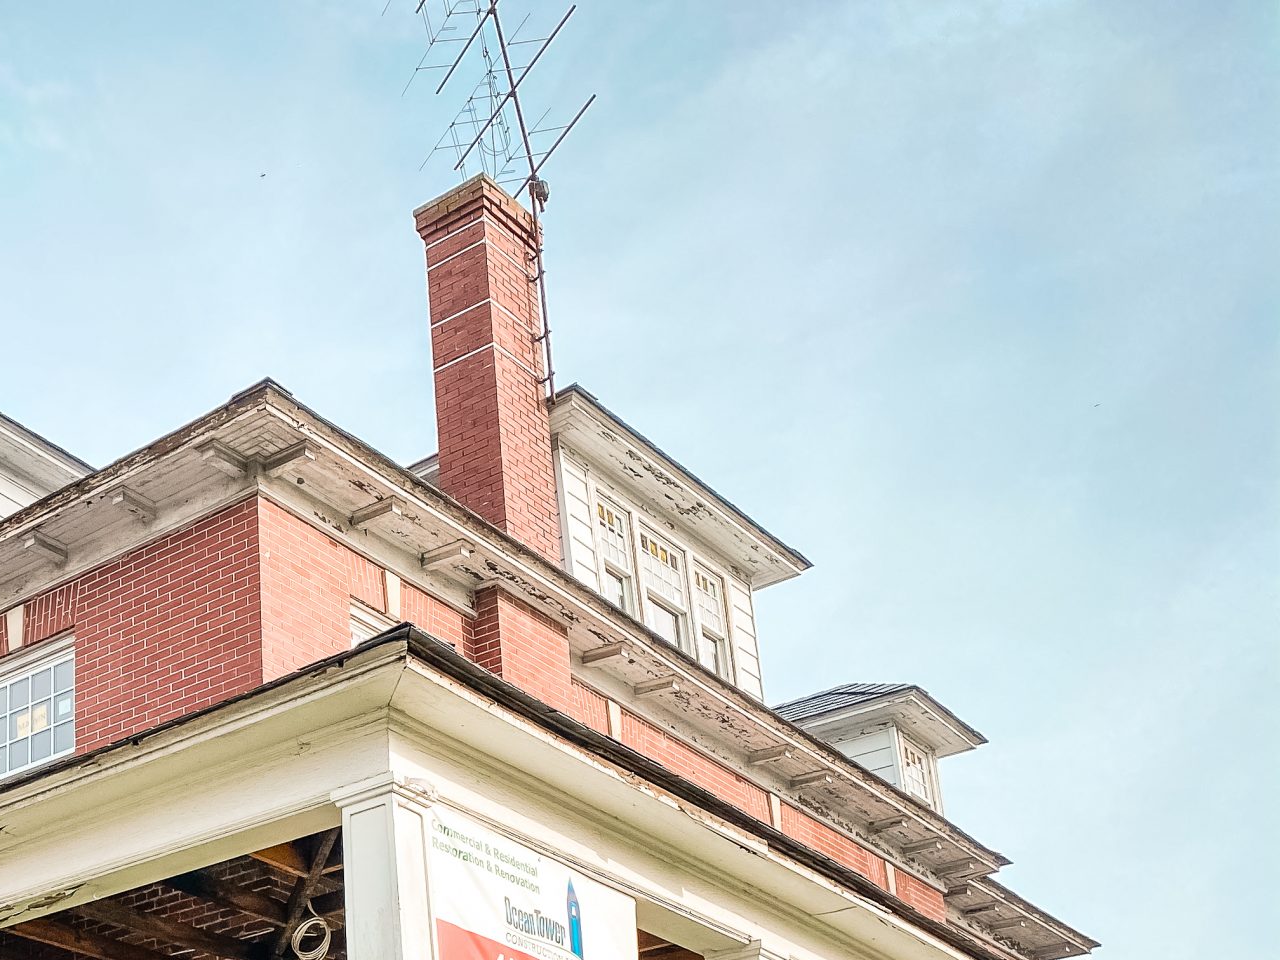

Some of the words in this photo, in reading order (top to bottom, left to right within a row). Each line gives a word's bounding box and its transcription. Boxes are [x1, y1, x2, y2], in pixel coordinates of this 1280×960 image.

[431, 818, 483, 852] Commercial
[485, 843, 491, 855] &
[493, 847, 538, 877] Residential
[432, 836, 484, 868] Restoration
[486, 860, 493, 873] &
[494, 864, 540, 894] Renovation
[504, 896, 566, 946] OceanTower
